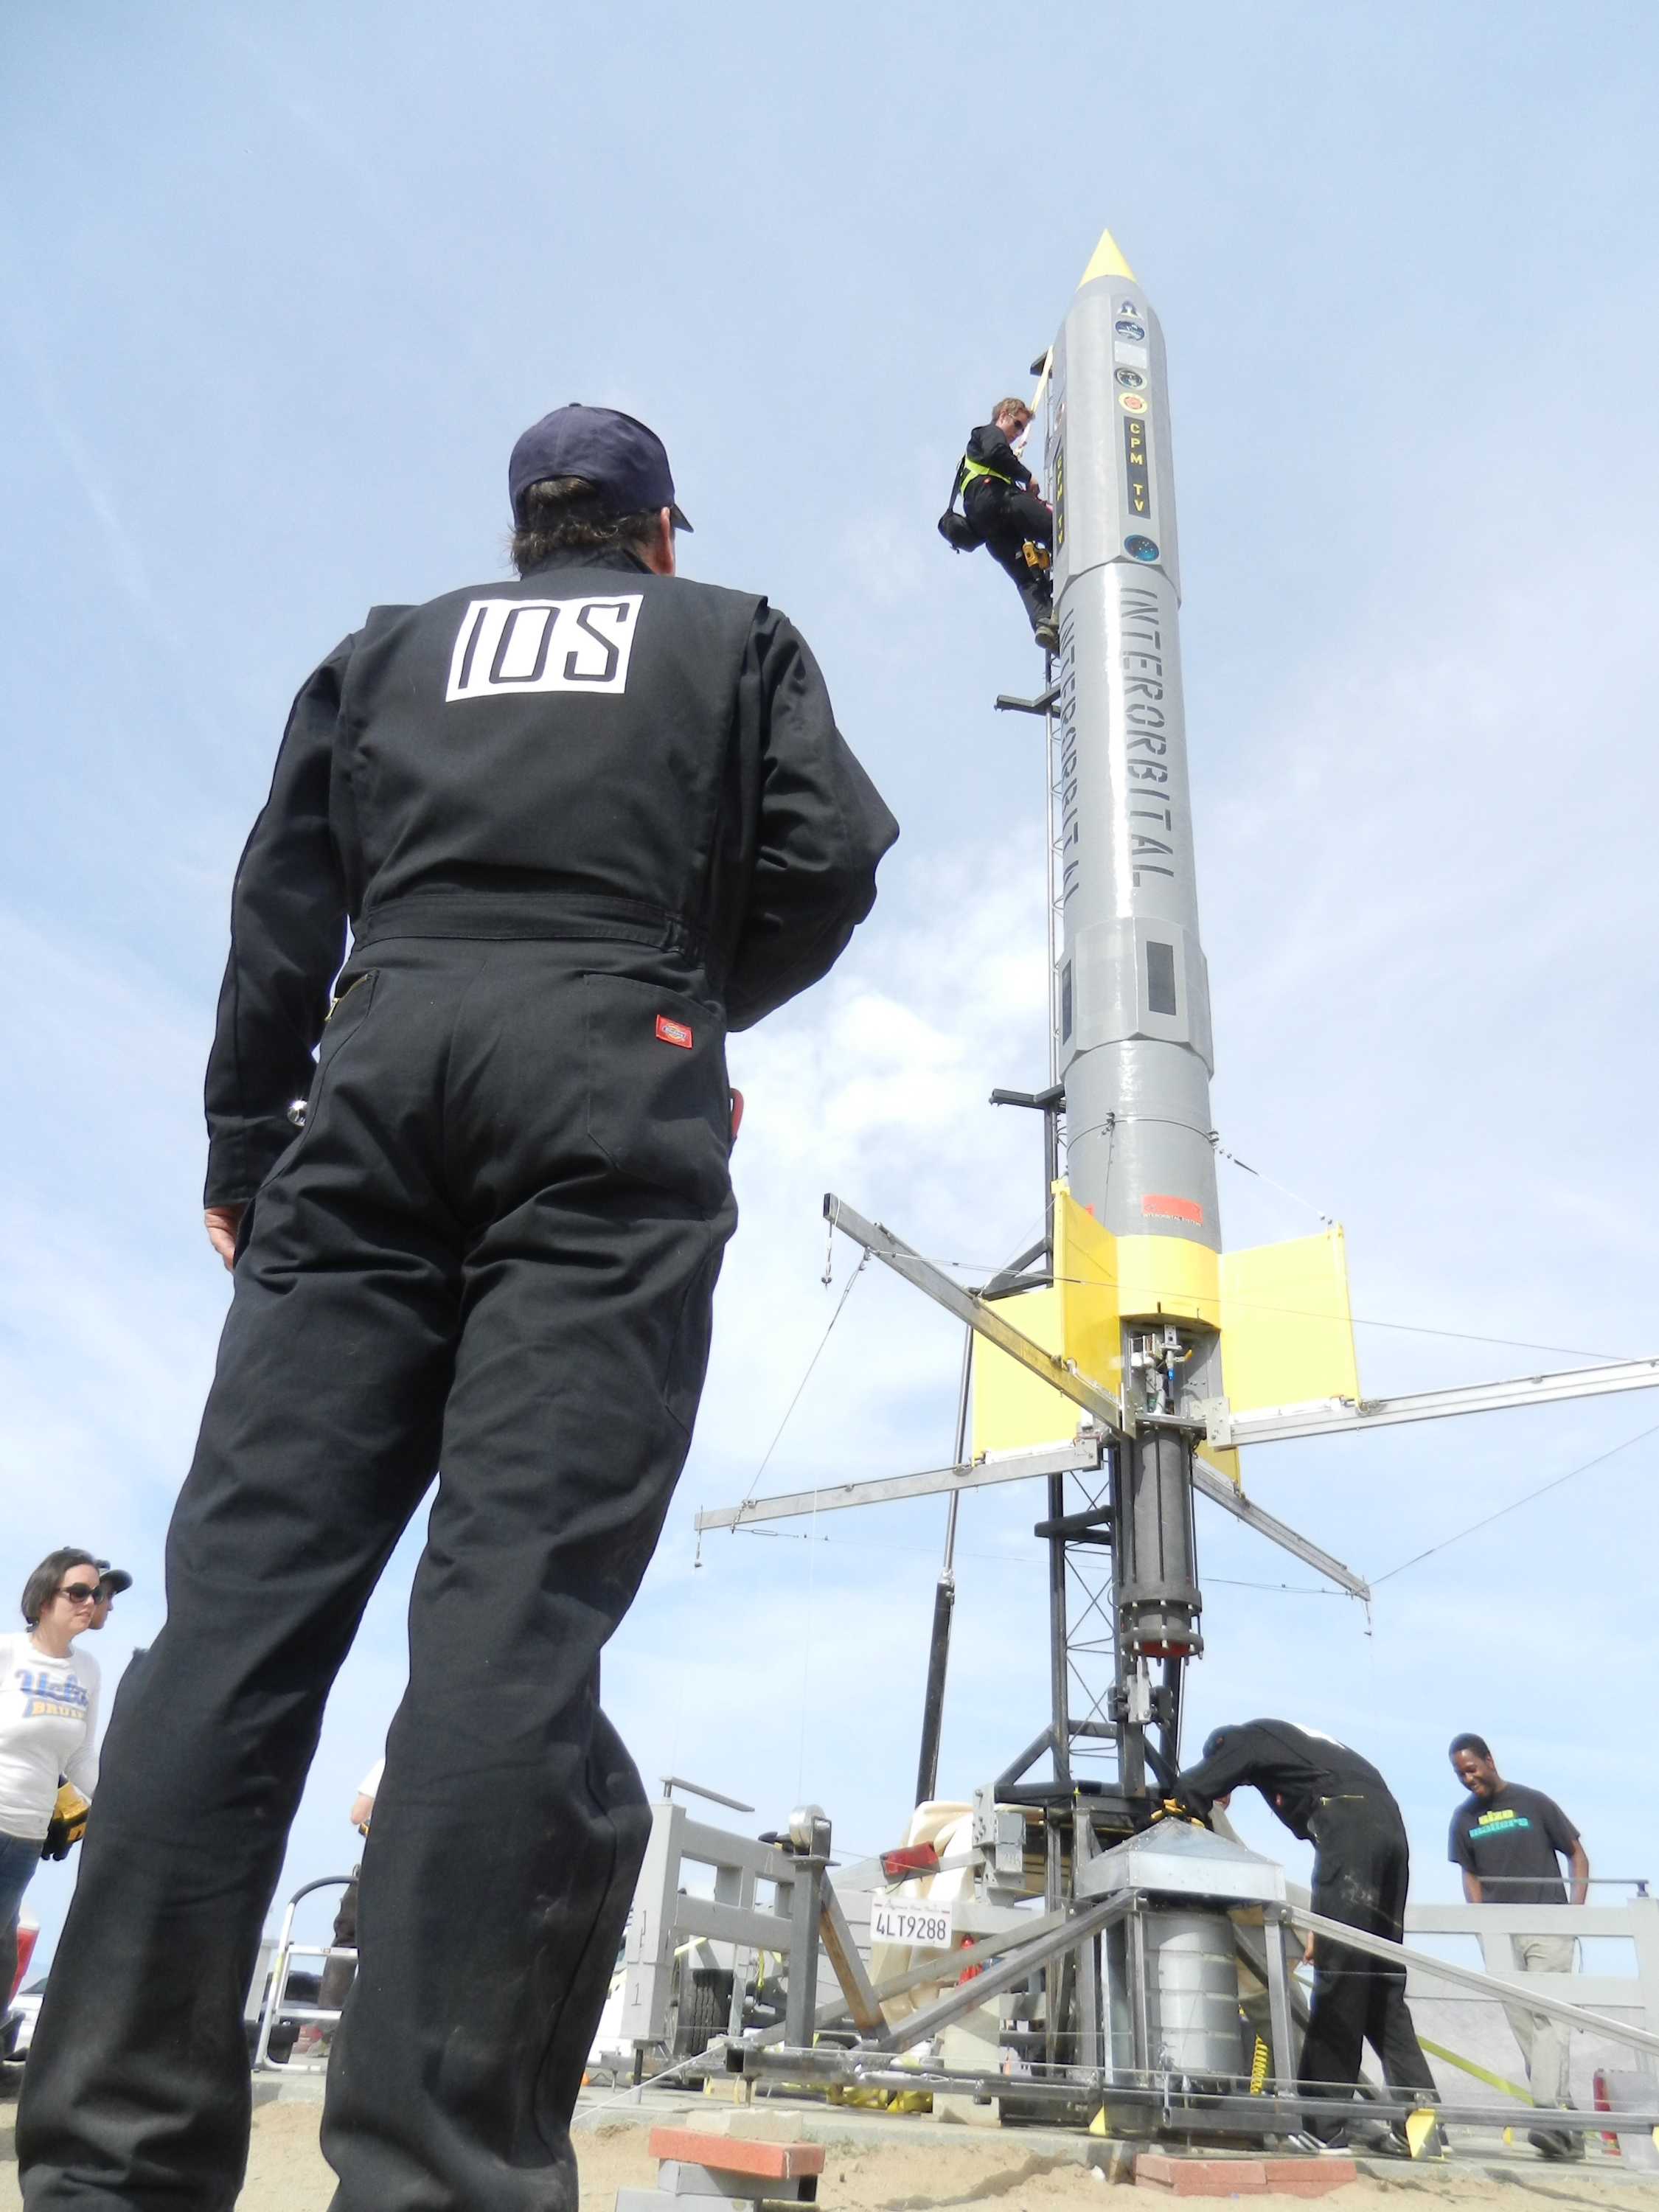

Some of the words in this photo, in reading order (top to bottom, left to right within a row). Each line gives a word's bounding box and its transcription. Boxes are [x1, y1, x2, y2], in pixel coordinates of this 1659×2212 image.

[1130, 423, 1143, 465] CPM
[1133, 484, 1144, 511] TV
[458, 602, 630, 689] IOS
[1120, 588, 1175, 888] INTERORBITAL
[876, 1913, 946, 1940] 4LT9288
